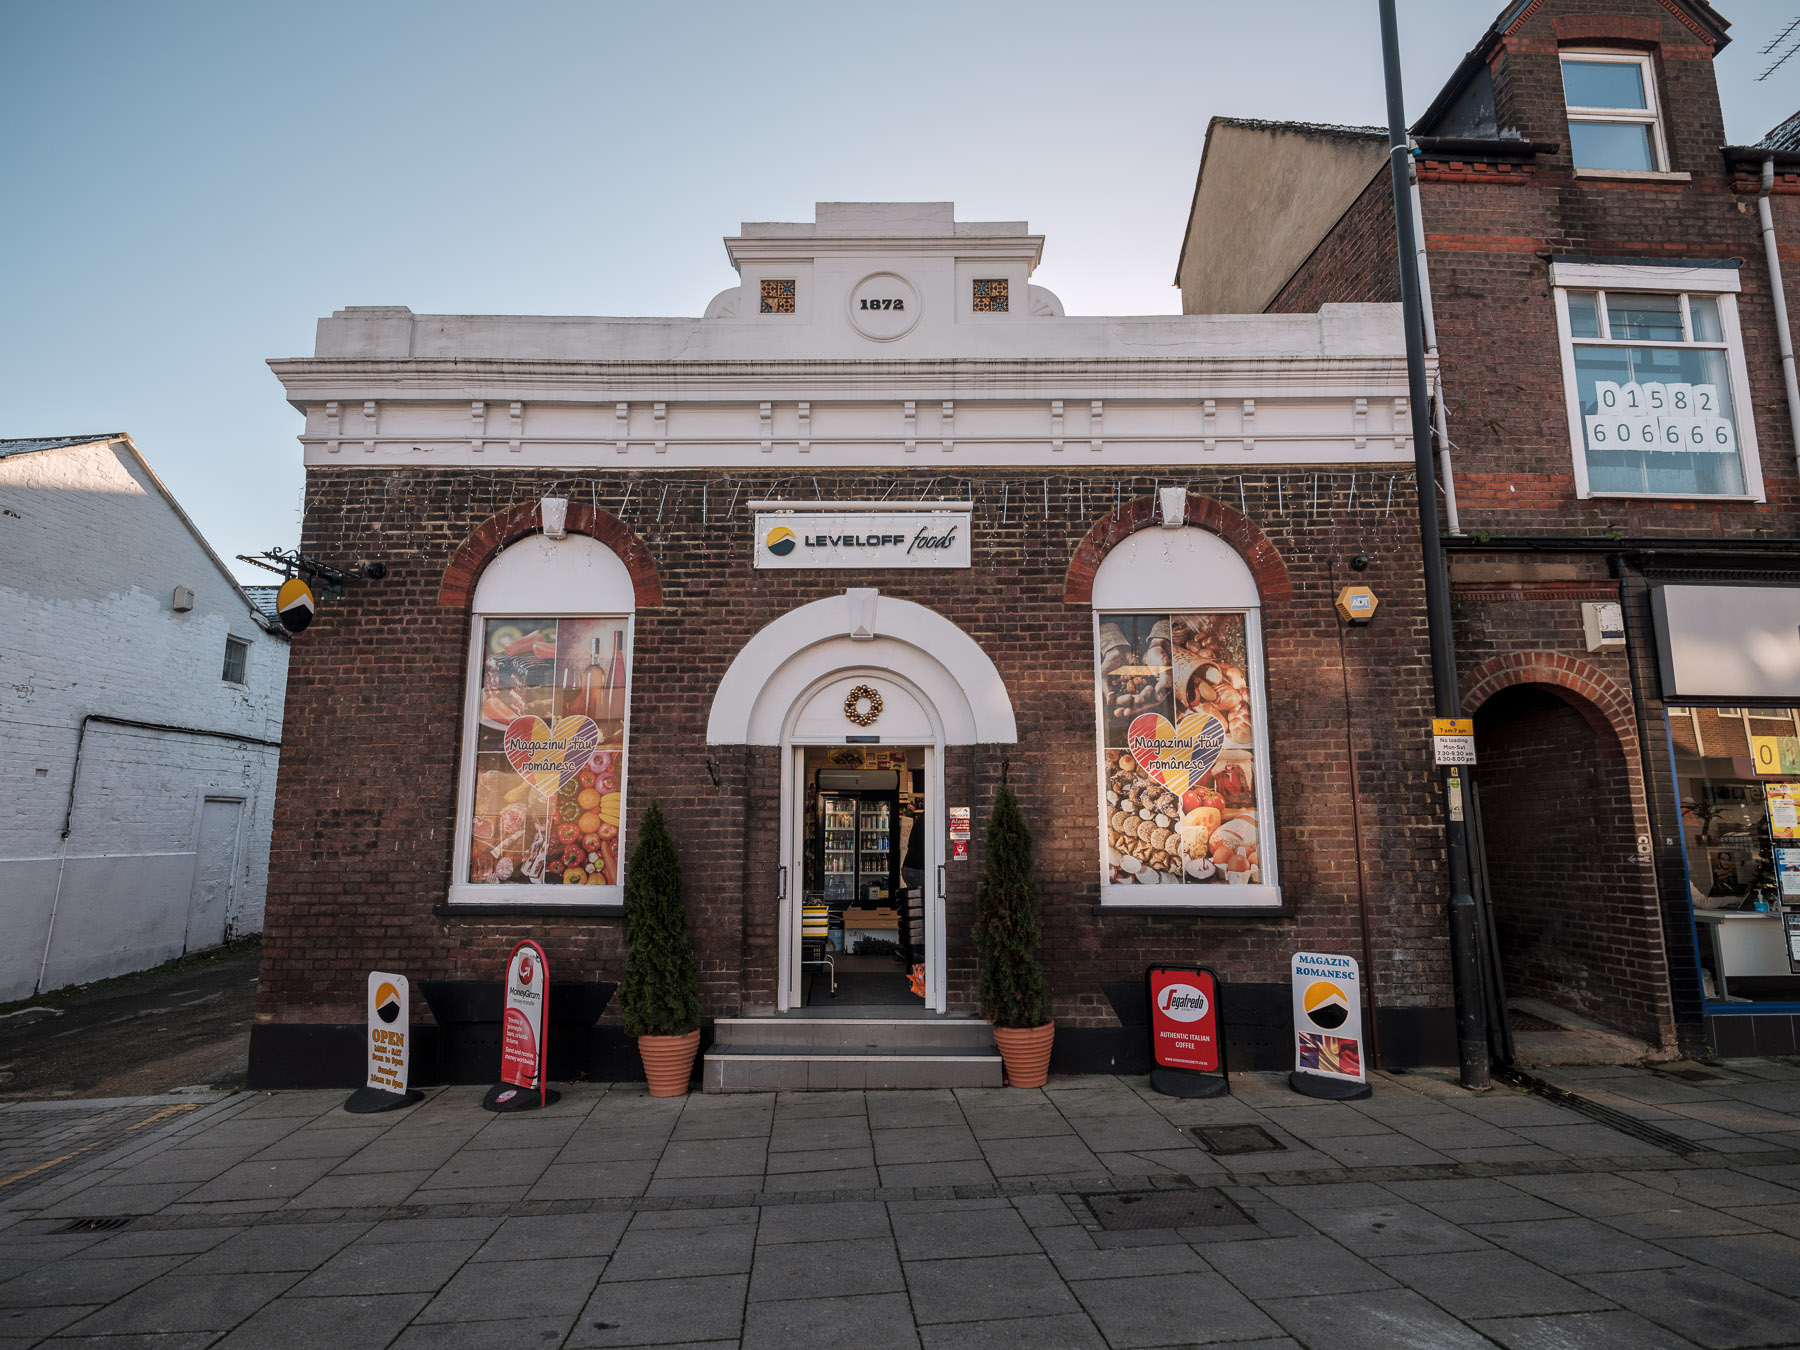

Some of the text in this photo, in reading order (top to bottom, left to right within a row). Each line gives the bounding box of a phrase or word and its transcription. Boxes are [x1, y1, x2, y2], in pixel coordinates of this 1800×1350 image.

[860, 300, 903, 310] 1872
[1603, 389, 1712, 411] 01582
[1593, 423, 1728, 445] 606666
[804, 525, 958, 554] LEVELOFF foods
[1352, 598, 1368, 606] ADT
[510, 738, 592, 757] Magazinul tău
[1134, 736, 1219, 755] Magazinul tău
[522, 759, 575, 770] românesc
[1148, 757, 1204, 769] românesc
[1300, 956, 1349, 966] MAGAZIN
[1296, 967, 1354, 979] ROMANESC
[510, 987, 540, 999] MoneyGram
[1162, 989, 1204, 1010] Segafredo
[371, 1028, 405, 1048] OPEN
[374, 1045, 387, 1053] MON
[516, 1057, 534, 1065] worldwide
[378, 1066, 397, 1077] Sunday
